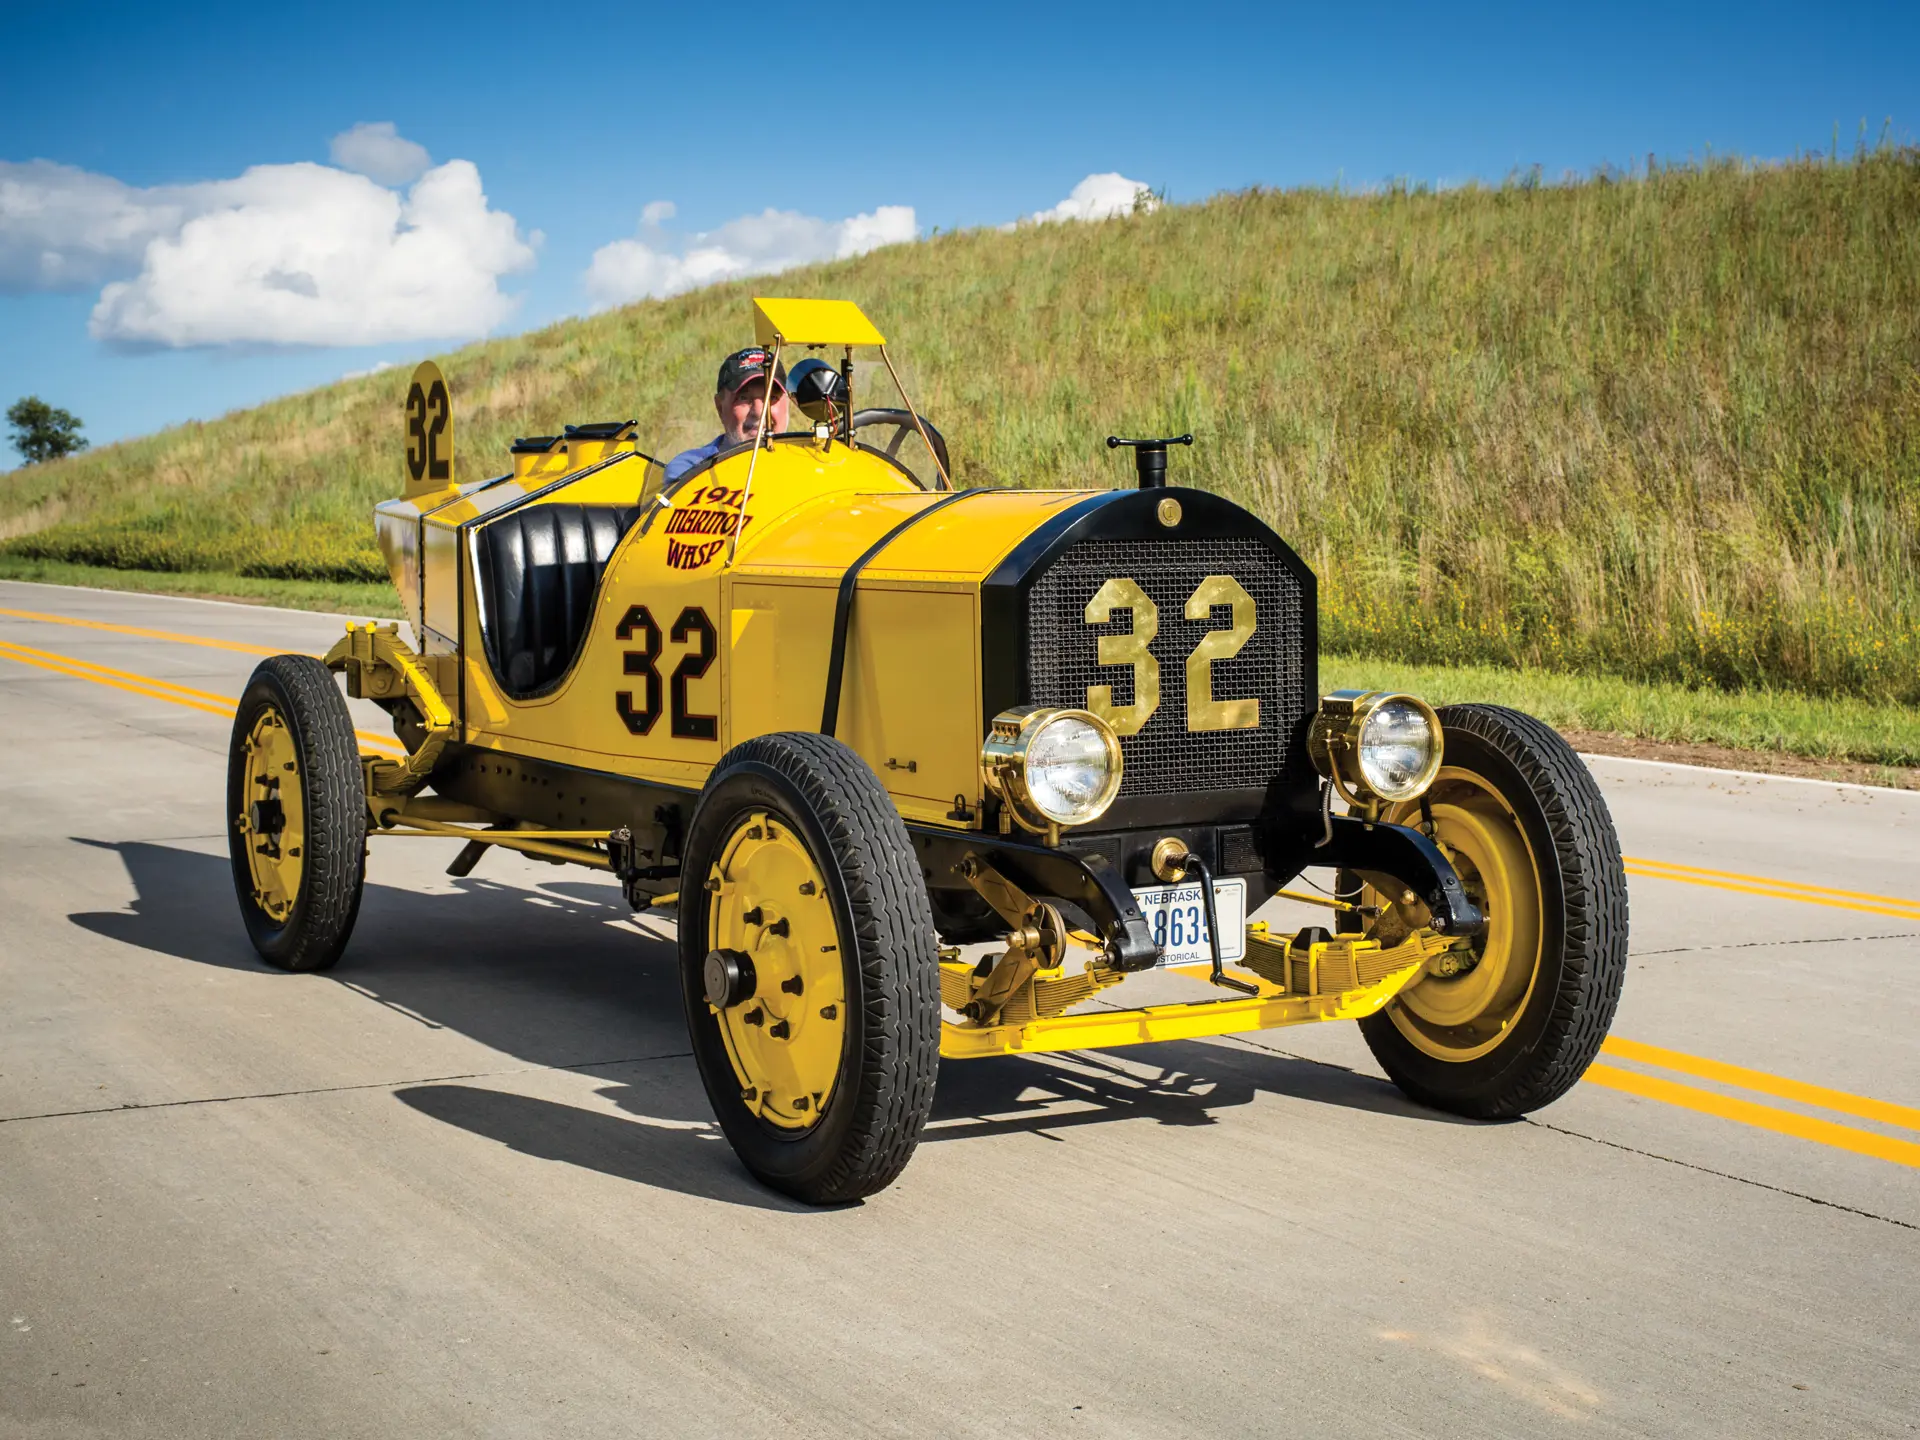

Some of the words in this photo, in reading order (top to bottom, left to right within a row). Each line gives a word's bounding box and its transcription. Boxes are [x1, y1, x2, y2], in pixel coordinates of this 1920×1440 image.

[406, 380, 449, 481] 32
[664, 508, 754, 537] MARMON
[666, 537, 725, 570] WASP
[615, 604, 718, 741] 32
[1084, 574, 1260, 736] 32
[1144, 889, 1205, 905] NEBRASK
